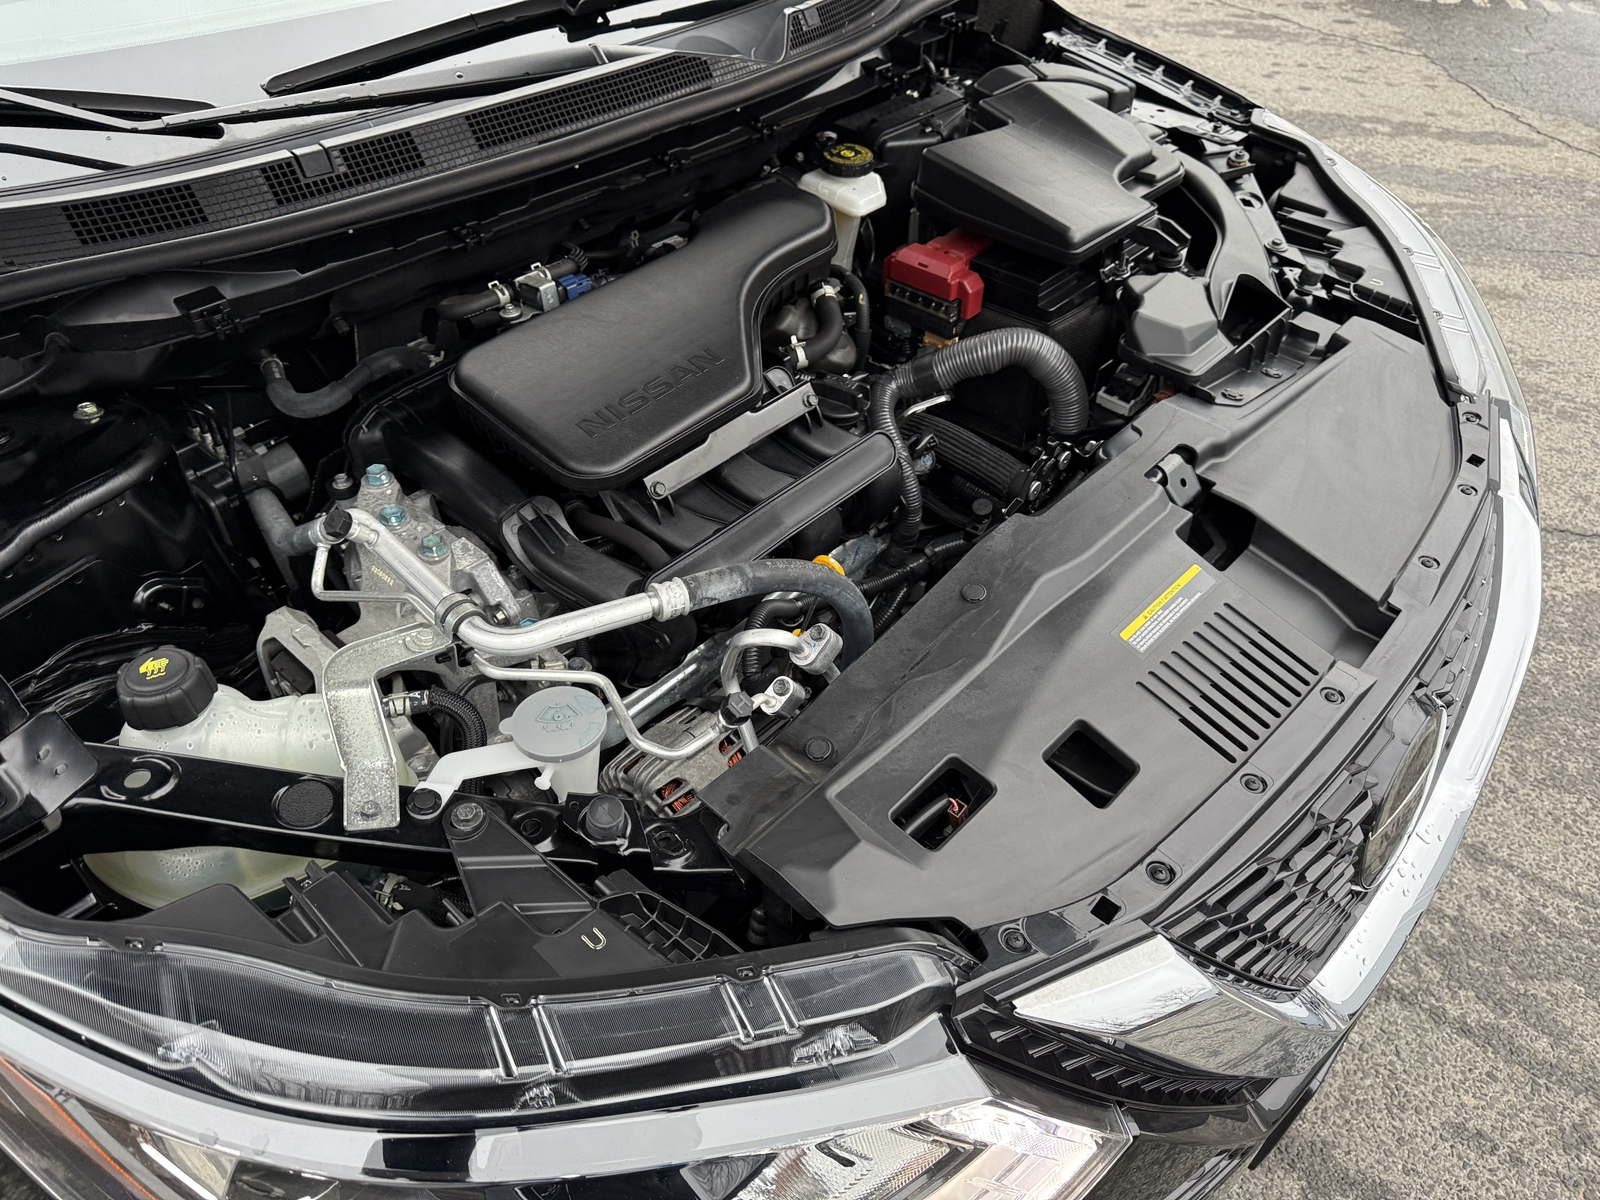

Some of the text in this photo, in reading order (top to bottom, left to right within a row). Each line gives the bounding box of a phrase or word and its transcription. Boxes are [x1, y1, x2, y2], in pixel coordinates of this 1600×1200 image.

[574, 347, 726, 439] NISSAN
[1147, 601, 1162, 615] CAUTION
[1163, 583, 1181, 600] ATTENTION
[730, 694, 752, 715] H
[580, 926, 607, 950] U
